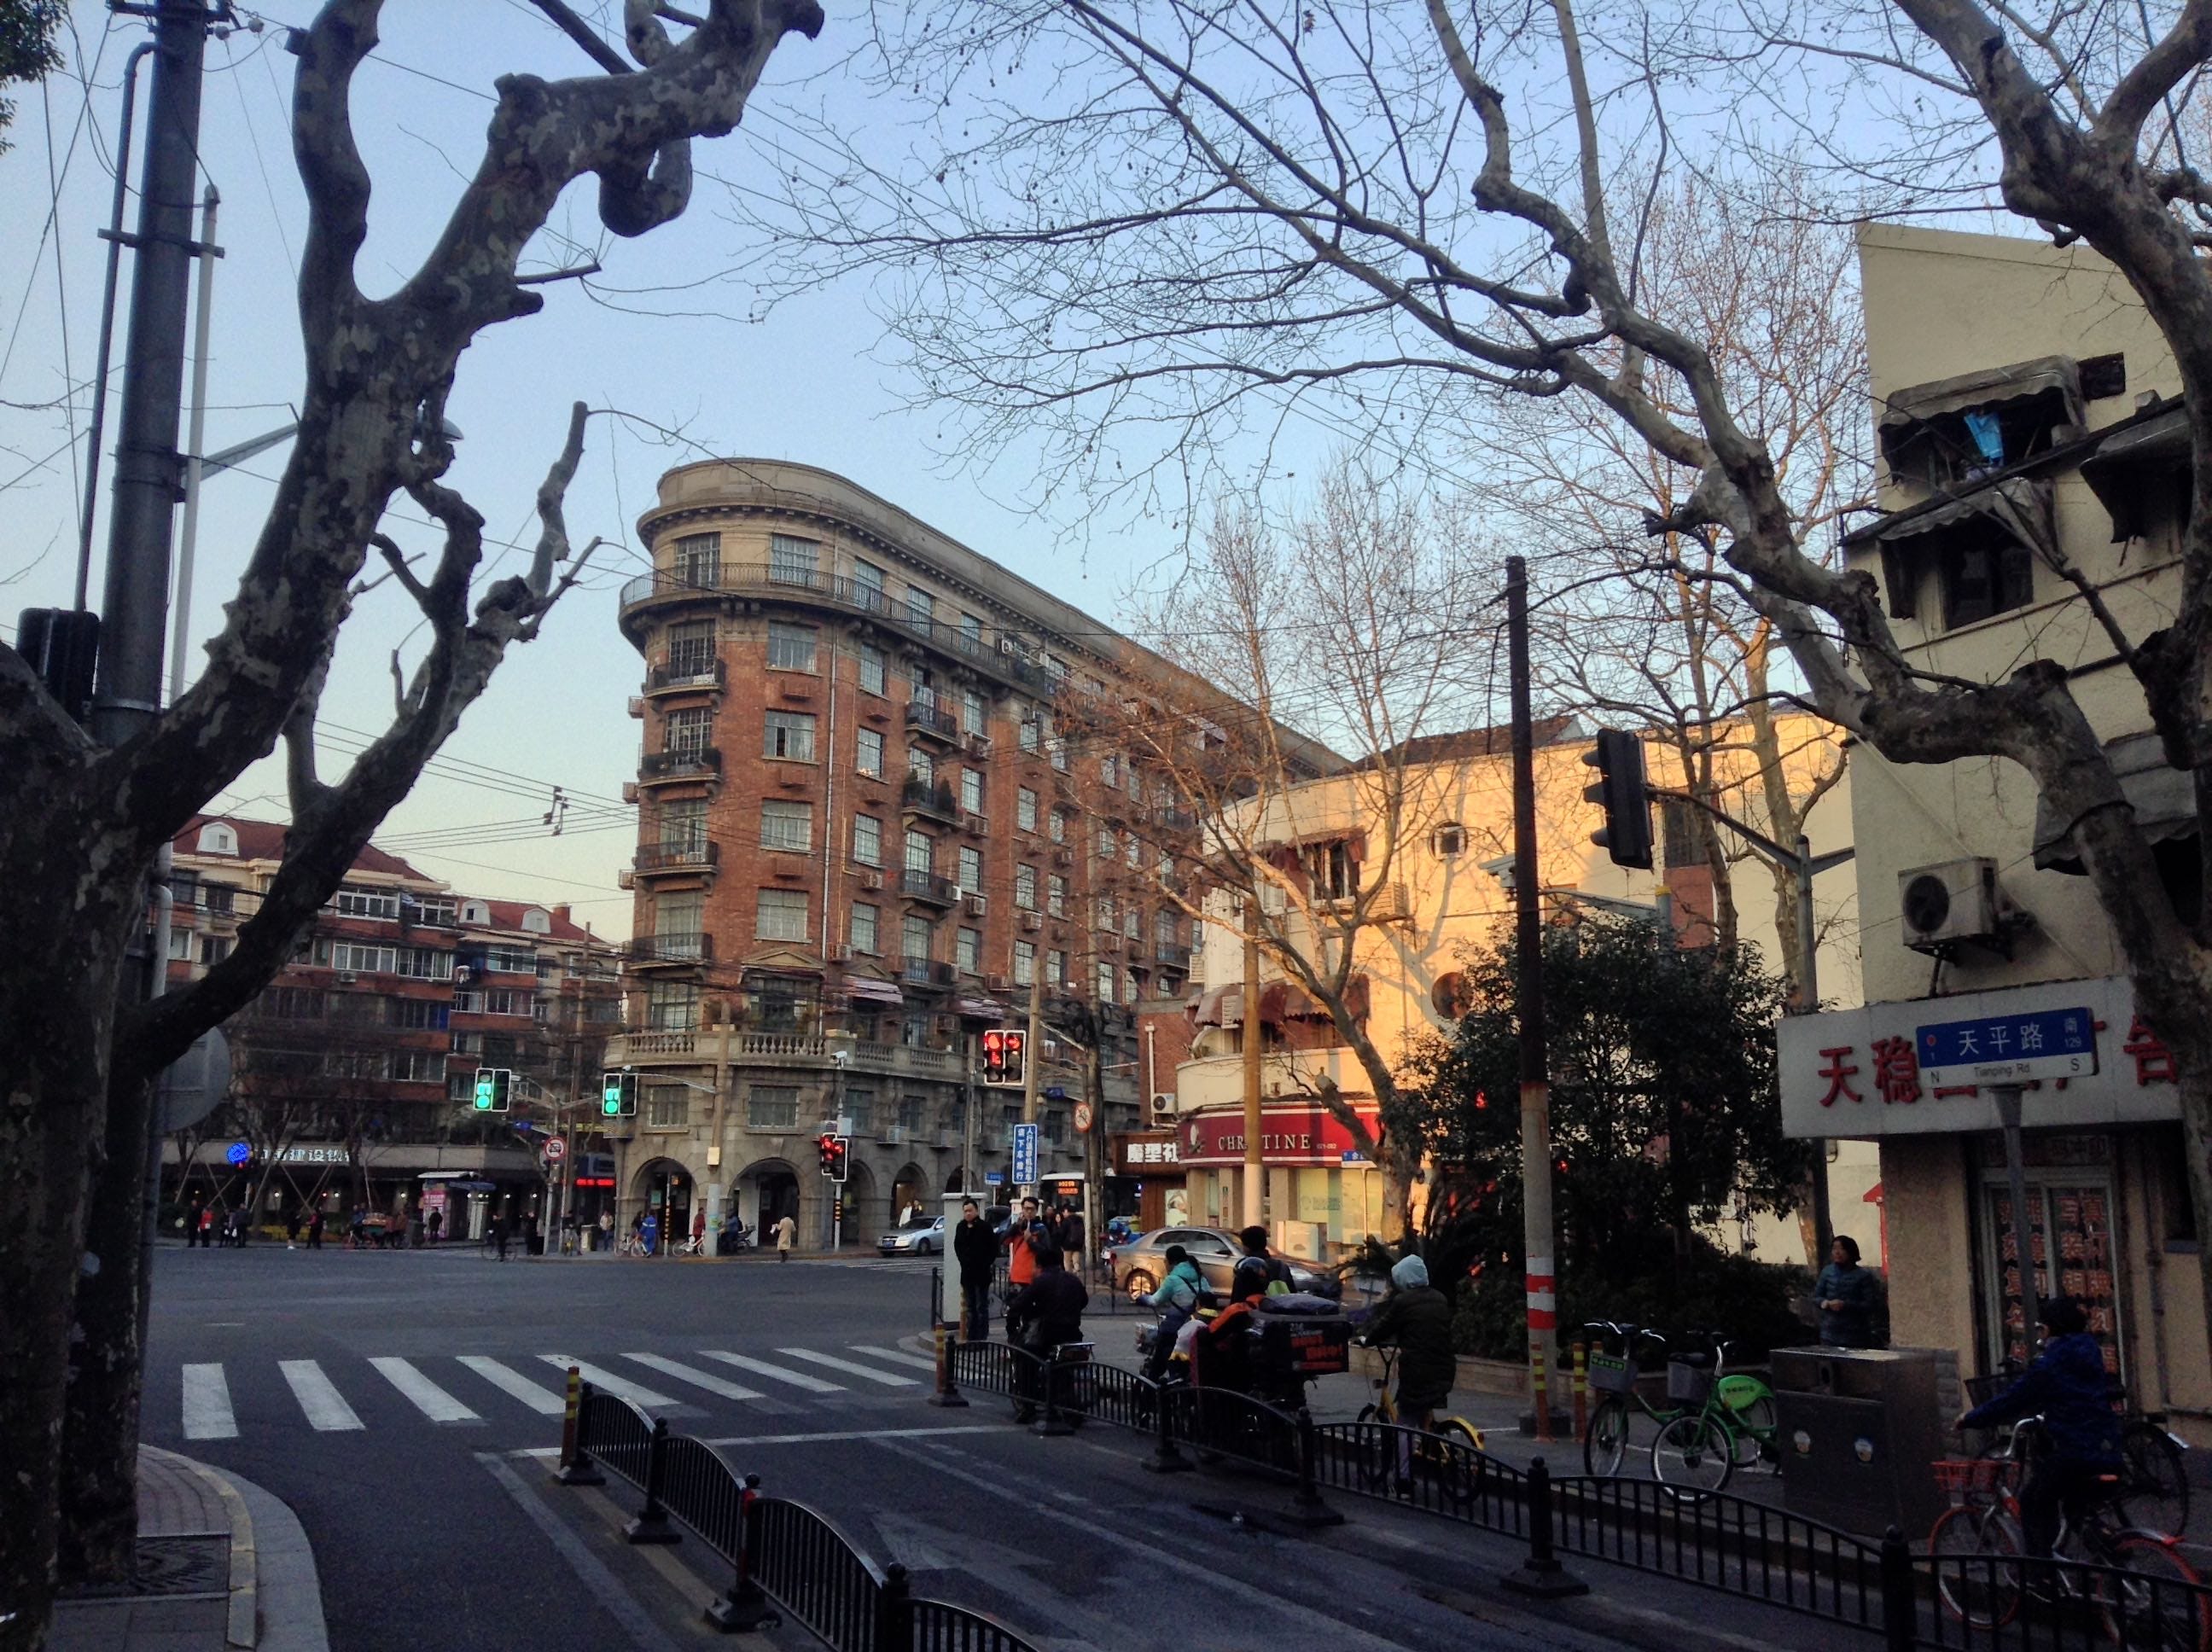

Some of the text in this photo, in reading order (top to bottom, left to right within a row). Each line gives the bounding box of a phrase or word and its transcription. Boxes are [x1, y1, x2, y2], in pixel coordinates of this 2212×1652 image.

[2063, 1016, 2079, 1034] 南
[1958, 1021, 2044, 1057] 天平路
[1974, 1063, 2031, 1079] Tianping Rd
[2070, 1057, 2081, 1072] S
[1930, 1070, 1941, 1084] N
[1218, 1134, 1311, 1151] CHRTINE
